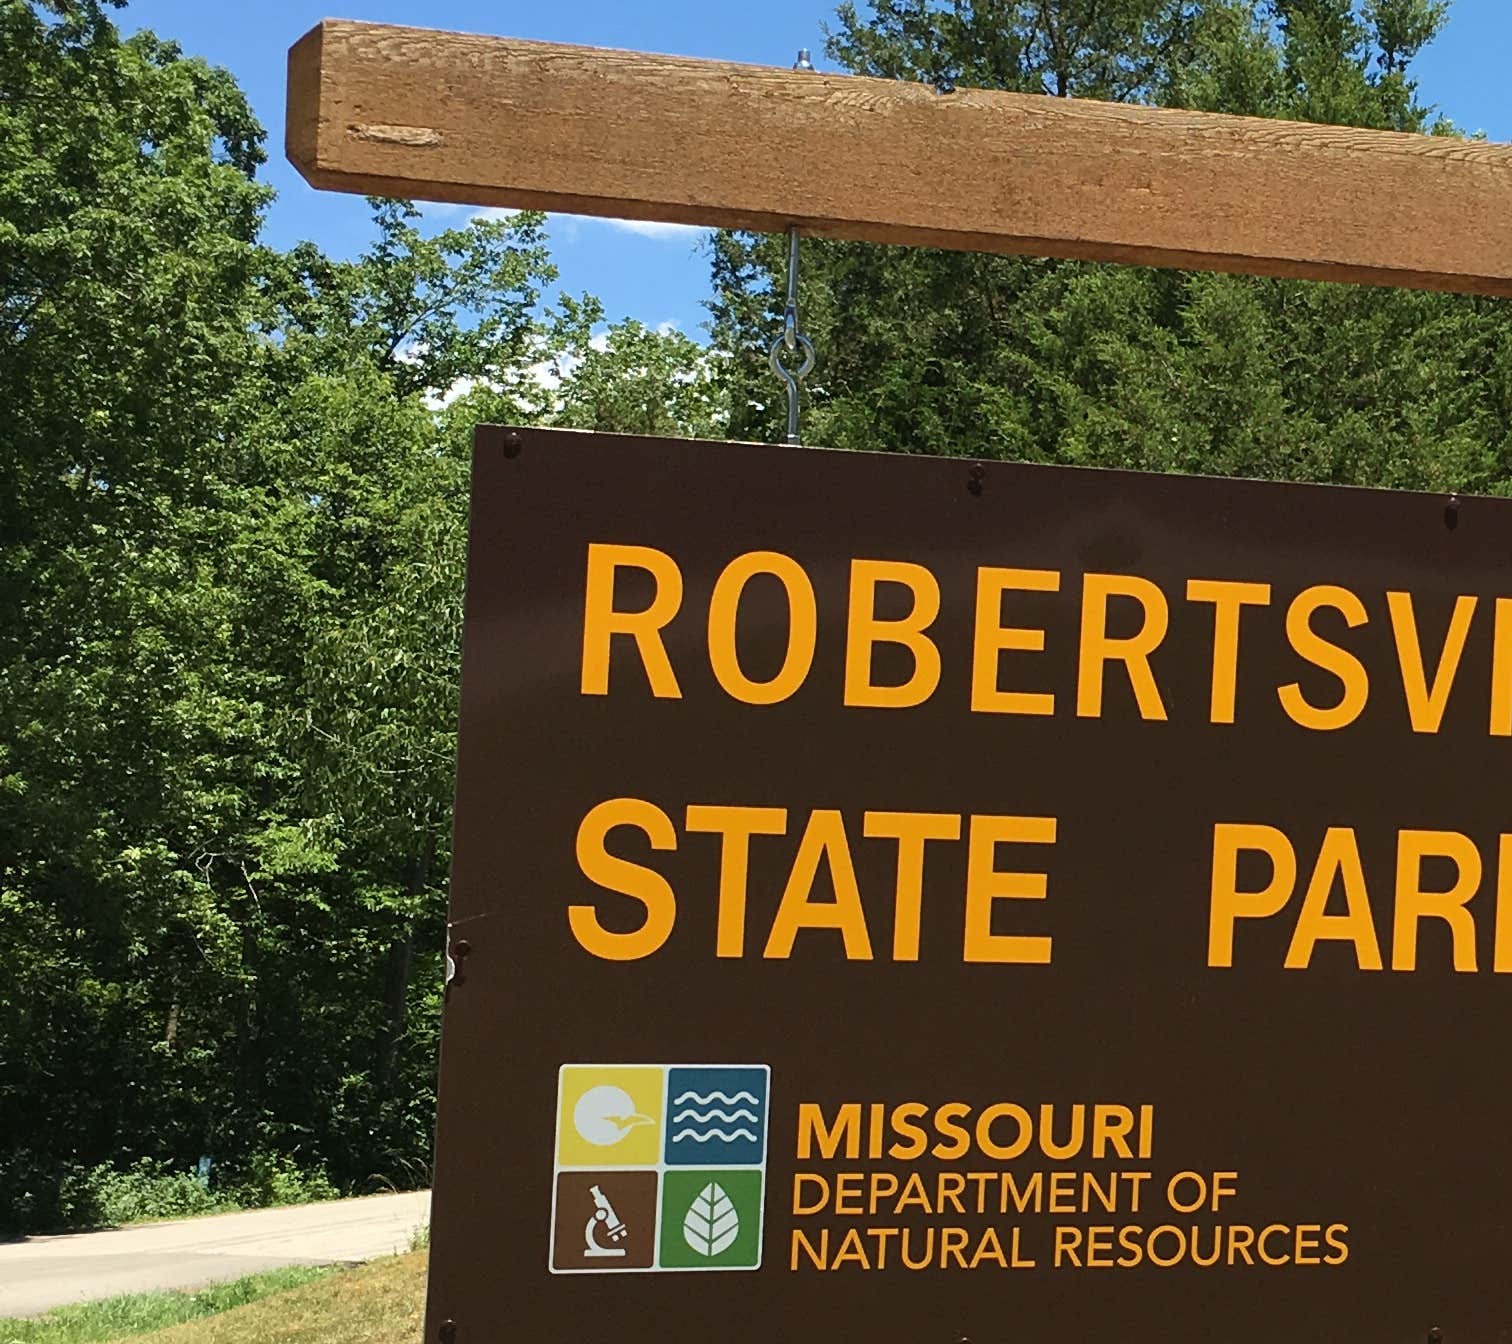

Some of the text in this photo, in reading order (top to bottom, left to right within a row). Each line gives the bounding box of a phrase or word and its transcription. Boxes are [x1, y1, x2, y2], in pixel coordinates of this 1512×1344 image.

[569, 798, 1056, 963] STATE
[798, 1103, 1153, 1159] MISSOURI
[793, 1172, 1237, 1214] DEPARTMENT OF
[791, 1224, 1348, 1270] NATURAL RESOURCES
